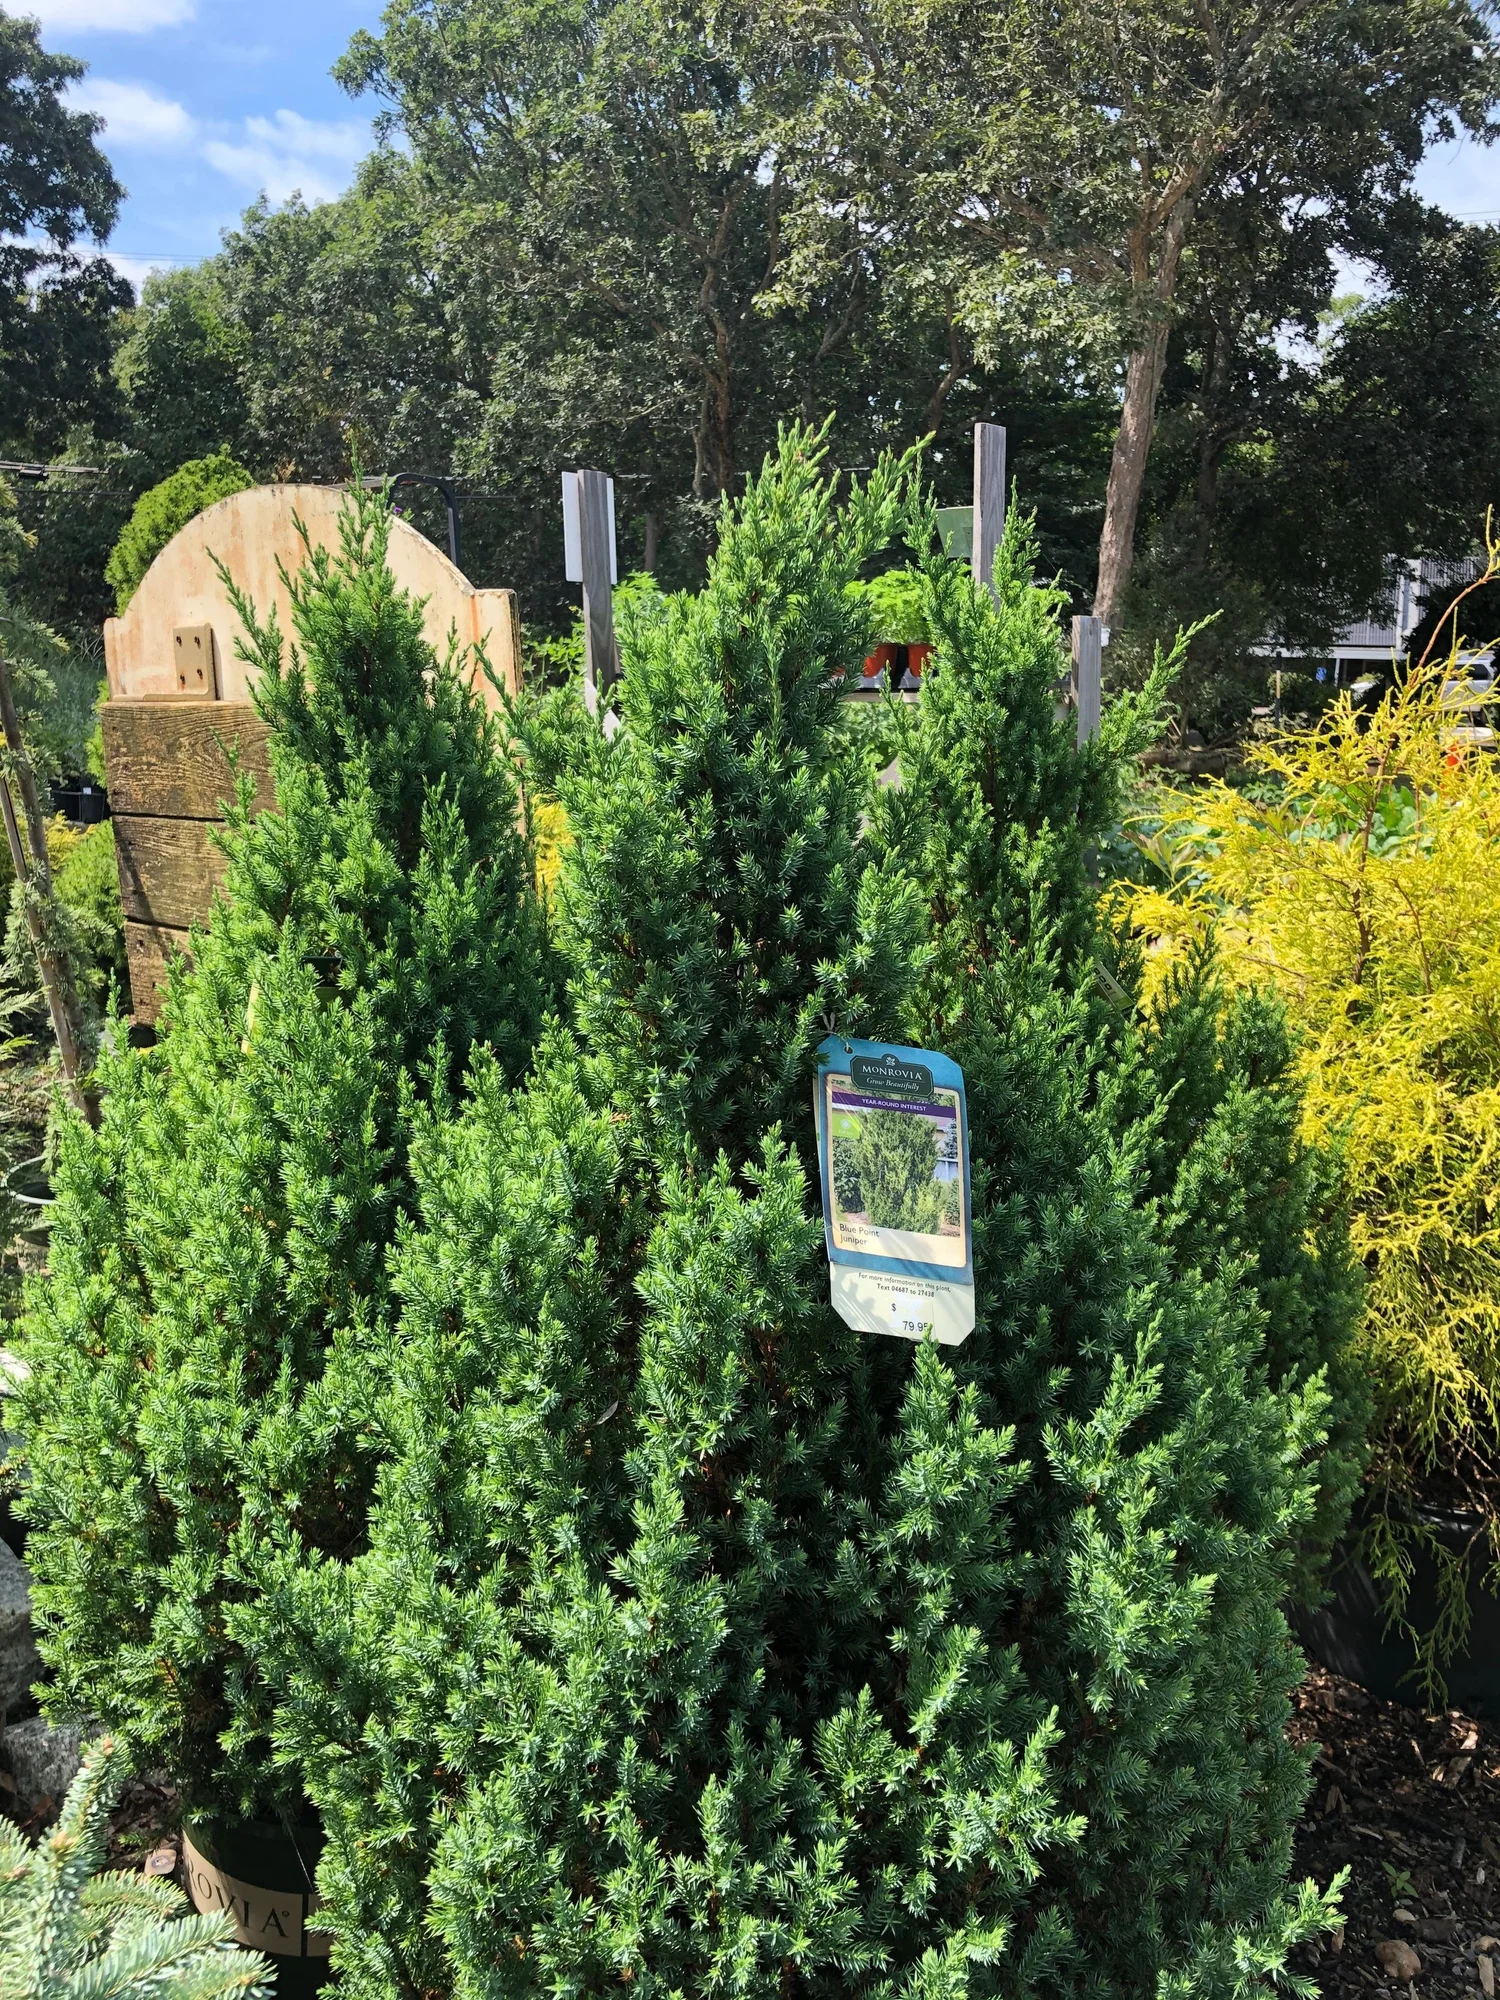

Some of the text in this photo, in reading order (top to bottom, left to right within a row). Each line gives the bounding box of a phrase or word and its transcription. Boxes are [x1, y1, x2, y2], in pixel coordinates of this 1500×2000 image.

[862, 1065, 922, 1080] MONROVIA
[866, 1077, 919, 1091] Grow Beautifully
[862, 1098, 926, 1111] YEAR-ROUND INTEREST
[839, 1223, 880, 1237] Blue Point
[840, 1234, 867, 1245] Juniper
[884, 1277, 916, 1287] information
[877, 1283, 890, 1291] Text
[918, 1290, 934, 1298] 27438
[891, 1303, 897, 1312] $
